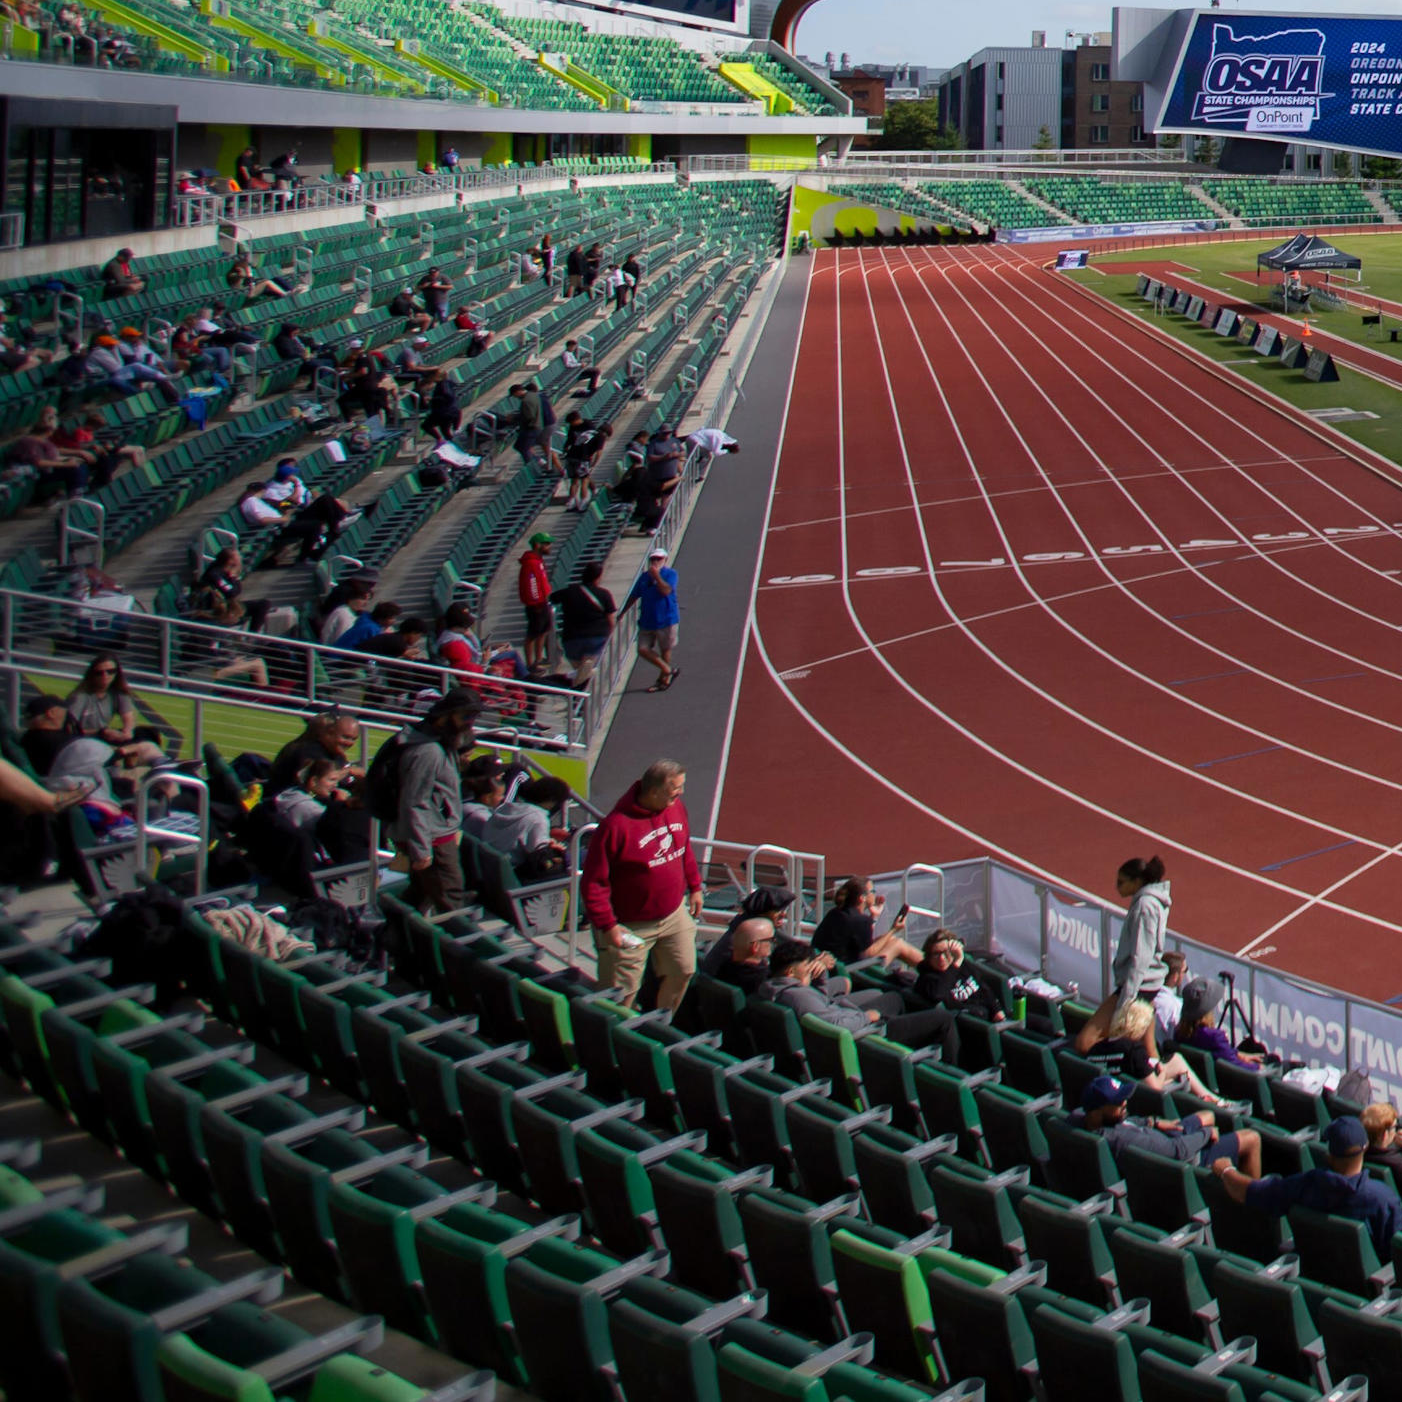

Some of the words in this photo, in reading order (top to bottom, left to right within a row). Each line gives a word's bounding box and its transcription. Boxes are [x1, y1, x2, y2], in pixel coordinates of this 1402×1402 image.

[1350, 42, 1386, 54] 2024
[1206, 57, 1320, 94] OSAA
[1351, 88, 1396, 99] TRACK
[1204, 96, 1233, 105] STATE
[1234, 96, 1316, 105] CHAMPIONSHIPS
[1350, 103, 1392, 114] STATE
[1256, 110, 1304, 123] OnPoint
[1306, 248, 1335, 258] OSAA
